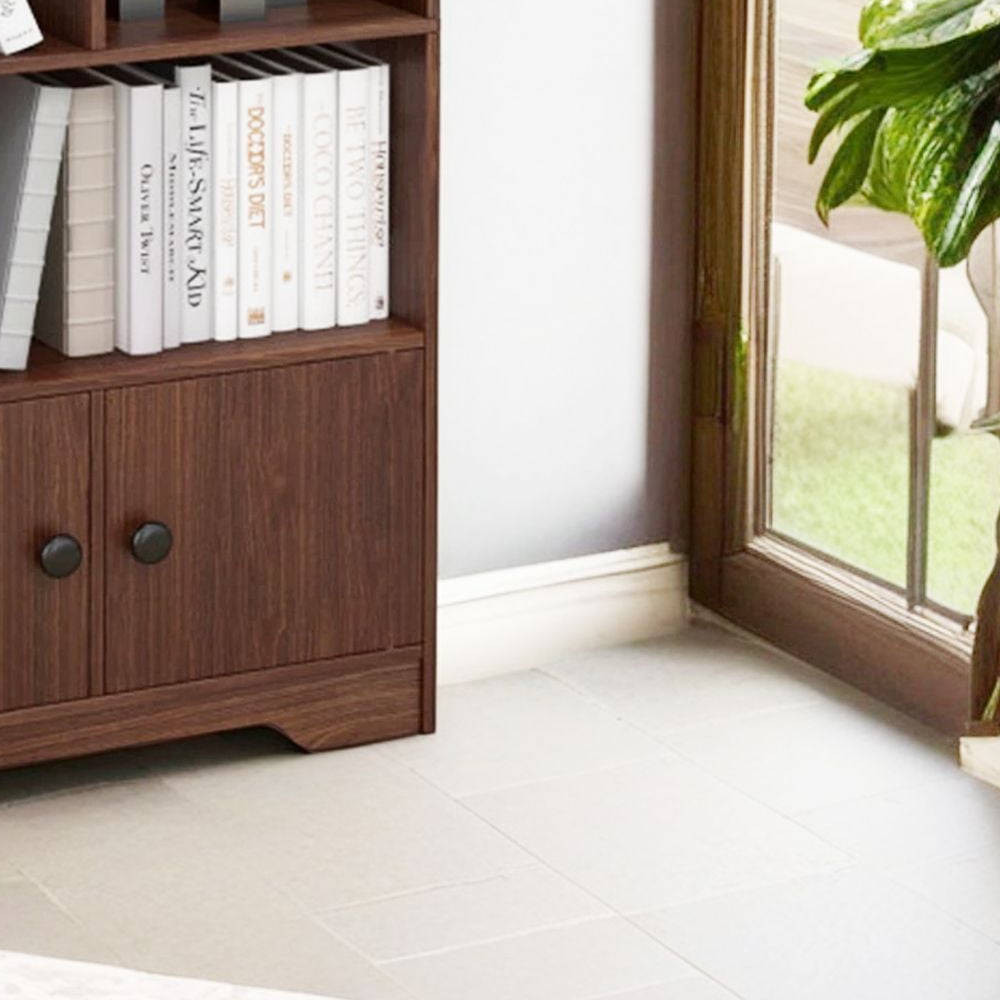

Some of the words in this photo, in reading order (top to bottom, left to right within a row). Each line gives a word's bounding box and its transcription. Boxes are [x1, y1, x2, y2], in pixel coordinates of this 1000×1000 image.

[138, 164, 155, 223] OLIVER
[346, 142, 366, 200] TWO
[247, 195, 266, 230] DIET
[138, 226, 155, 276] TWIST
